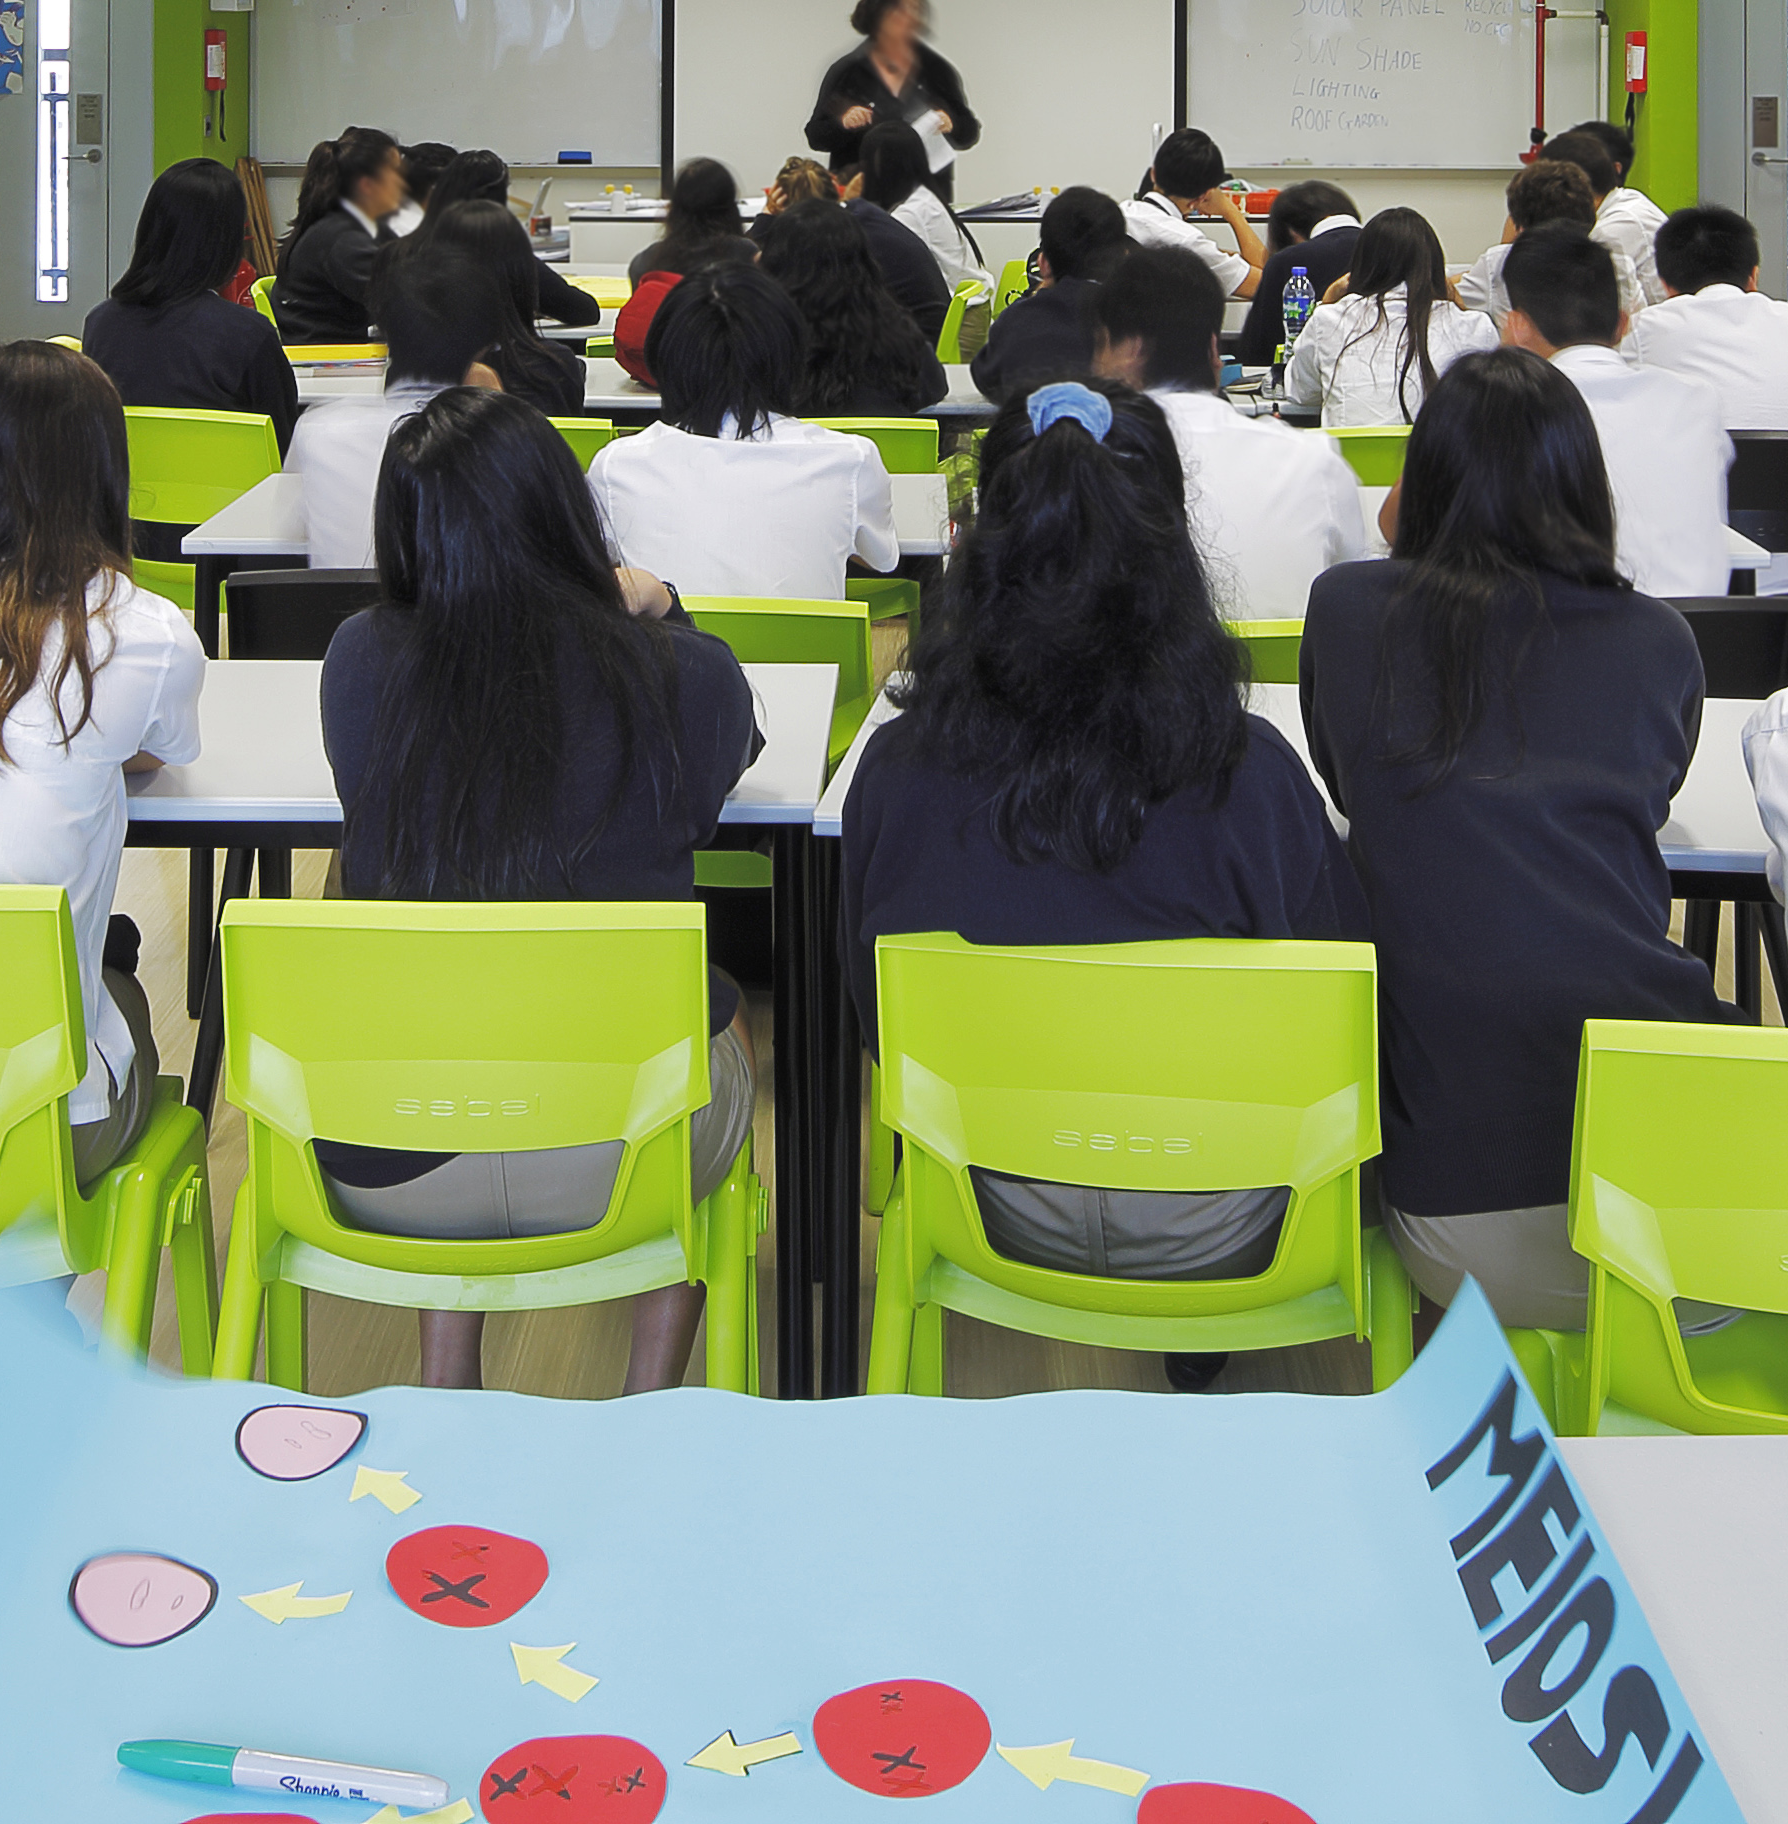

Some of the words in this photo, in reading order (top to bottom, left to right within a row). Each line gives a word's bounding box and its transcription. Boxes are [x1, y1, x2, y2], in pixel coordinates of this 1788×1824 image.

[1290, 27, 1342, 67] SUN
[1356, 37, 1423, 72] SHADE
[1292, 74, 1381, 100] LIGHTING
[1291, 105, 1333, 132] ROOF
[1337, 110, 1390, 132] GARDEN
